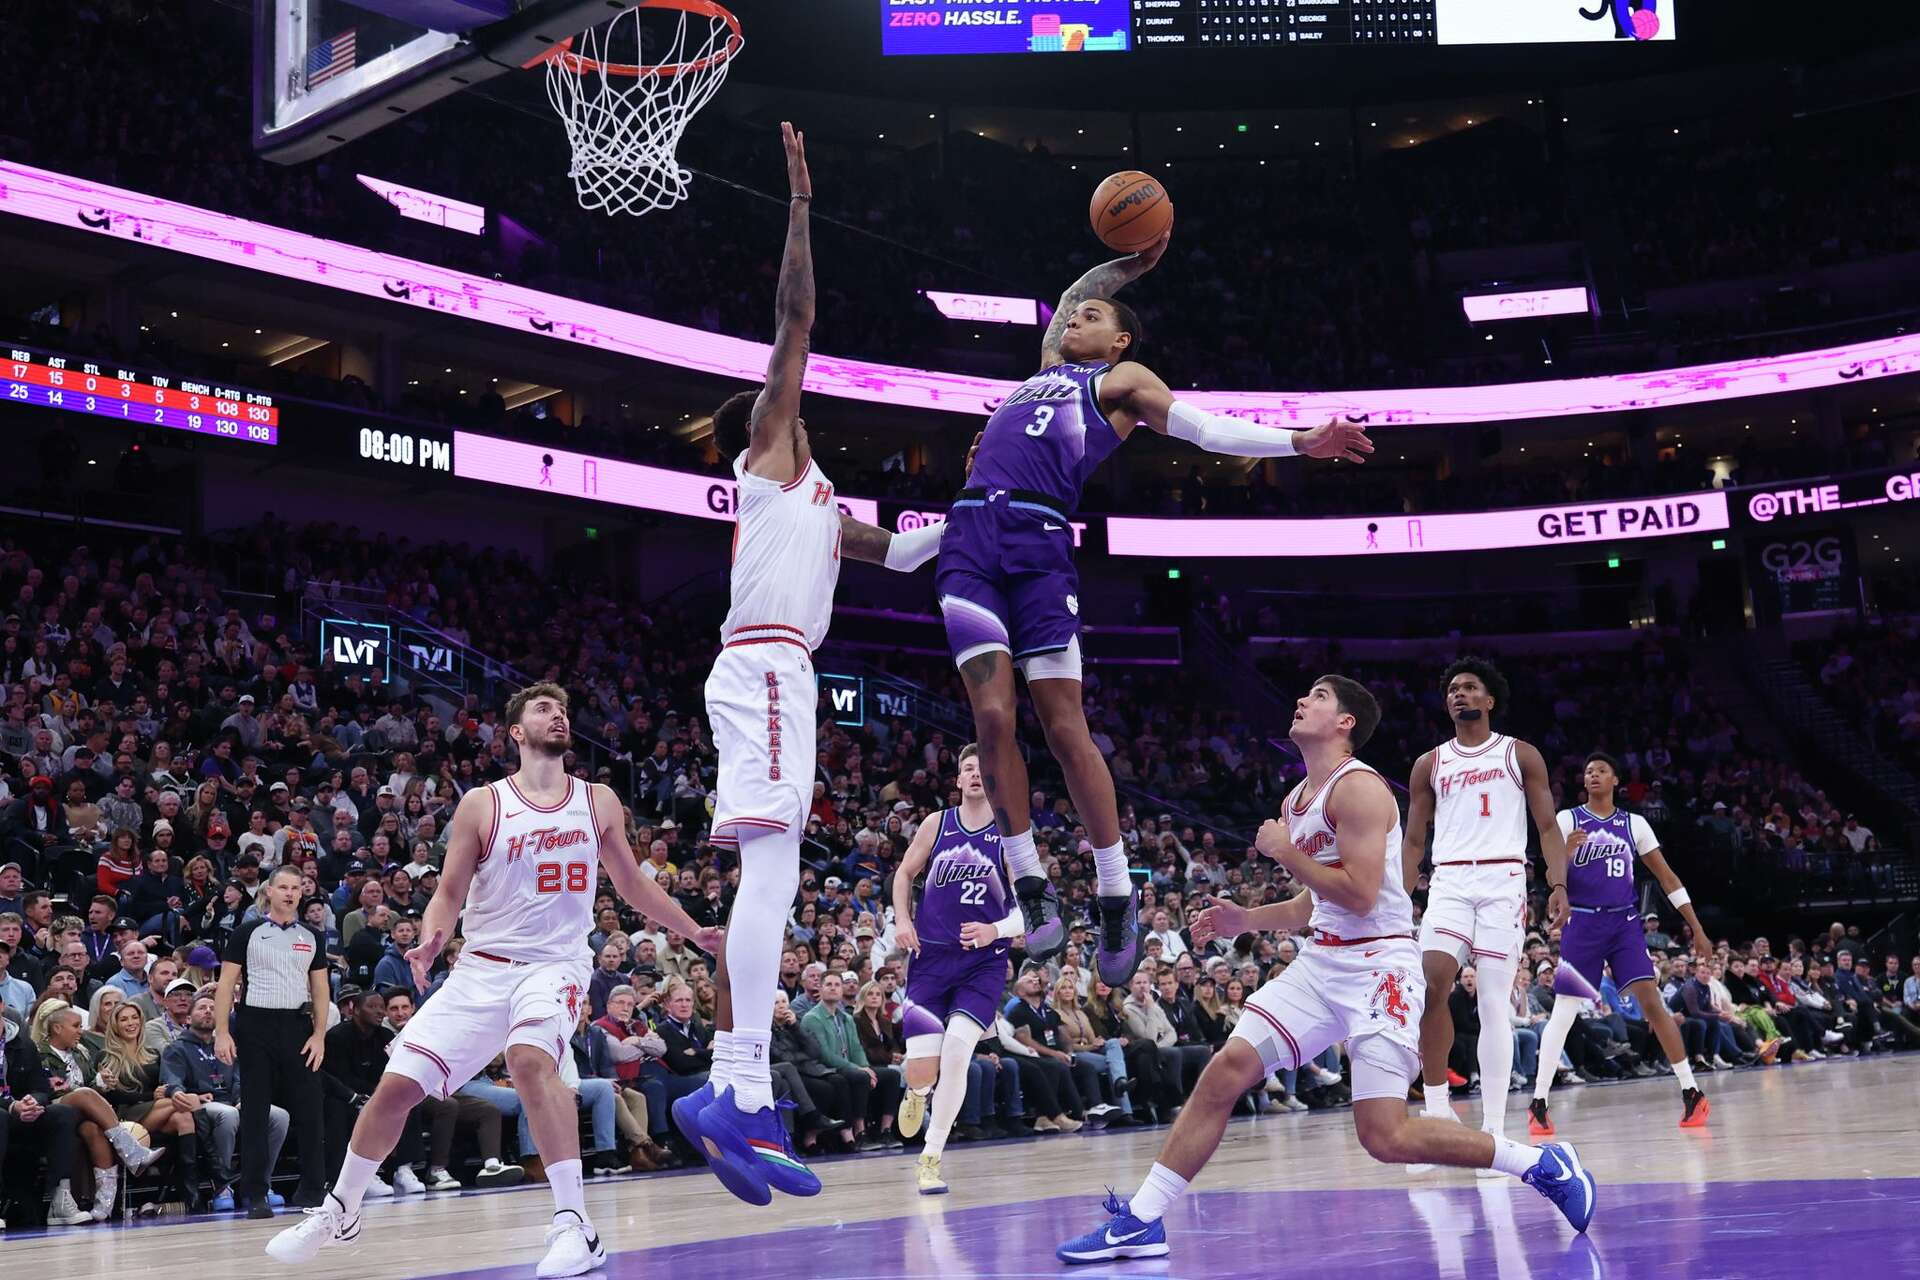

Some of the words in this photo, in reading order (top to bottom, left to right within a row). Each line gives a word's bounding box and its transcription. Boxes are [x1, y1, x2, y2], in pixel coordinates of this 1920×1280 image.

[889, 12, 941, 27] ZERO
[944, 10, 1022, 26] HASSLE.
[1145, 17, 1174, 26] DURANT
[1298, 14, 1328, 23] GEORGE
[1146, 34, 1185, 43] THOMPSON
[1300, 32, 1325, 40] BAILEY
[1109, 184, 1158, 216] Wilson
[12, 350, 30, 362] REB
[48, 357, 66, 369] AST
[84, 364, 101, 375] STL
[118, 370, 135, 382] BLK
[152, 376, 169, 388] TOV
[181, 382, 210, 396] BENCH
[13, 364, 28, 378] 17
[49, 371, 64, 385] 15
[86, 378, 97, 391] 0
[121, 384, 131, 397] 3
[190, 396, 199, 410] 3
[215, 401, 239, 417] 108
[247, 407, 270, 422] 130
[9, 383, 29, 399] 25
[47, 390, 63, 406] 14
[86, 397, 96, 411] 3
[121, 403, 129, 417] 1
[154, 409, 164, 423] 2
[187, 415, 202, 429] 19
[215, 420, 238, 435] 130
[247, 425, 270, 441] 108
[1025, 405, 1055, 437] 3
[360, 428, 414, 465] 08:00
[419, 438, 450, 472] PM
[1538, 509, 1607, 539] GET
[1618, 502, 1700, 532] PAID
[1762, 537, 1842, 572] G2G
[333, 636, 381, 665] LVT
[764, 671, 781, 781] ROCKETS
[1440, 767, 1505, 800] H-Town
[1479, 792, 1491, 817] 1
[507, 826, 590, 864] H-Town
[983, 833, 999, 844] LVT
[1573, 841, 1627, 868] UTAH
[1605, 857, 1626, 878] 19
[535, 861, 590, 896] 28
[935, 858, 996, 889] UTAH
[959, 880, 988, 906] 22
